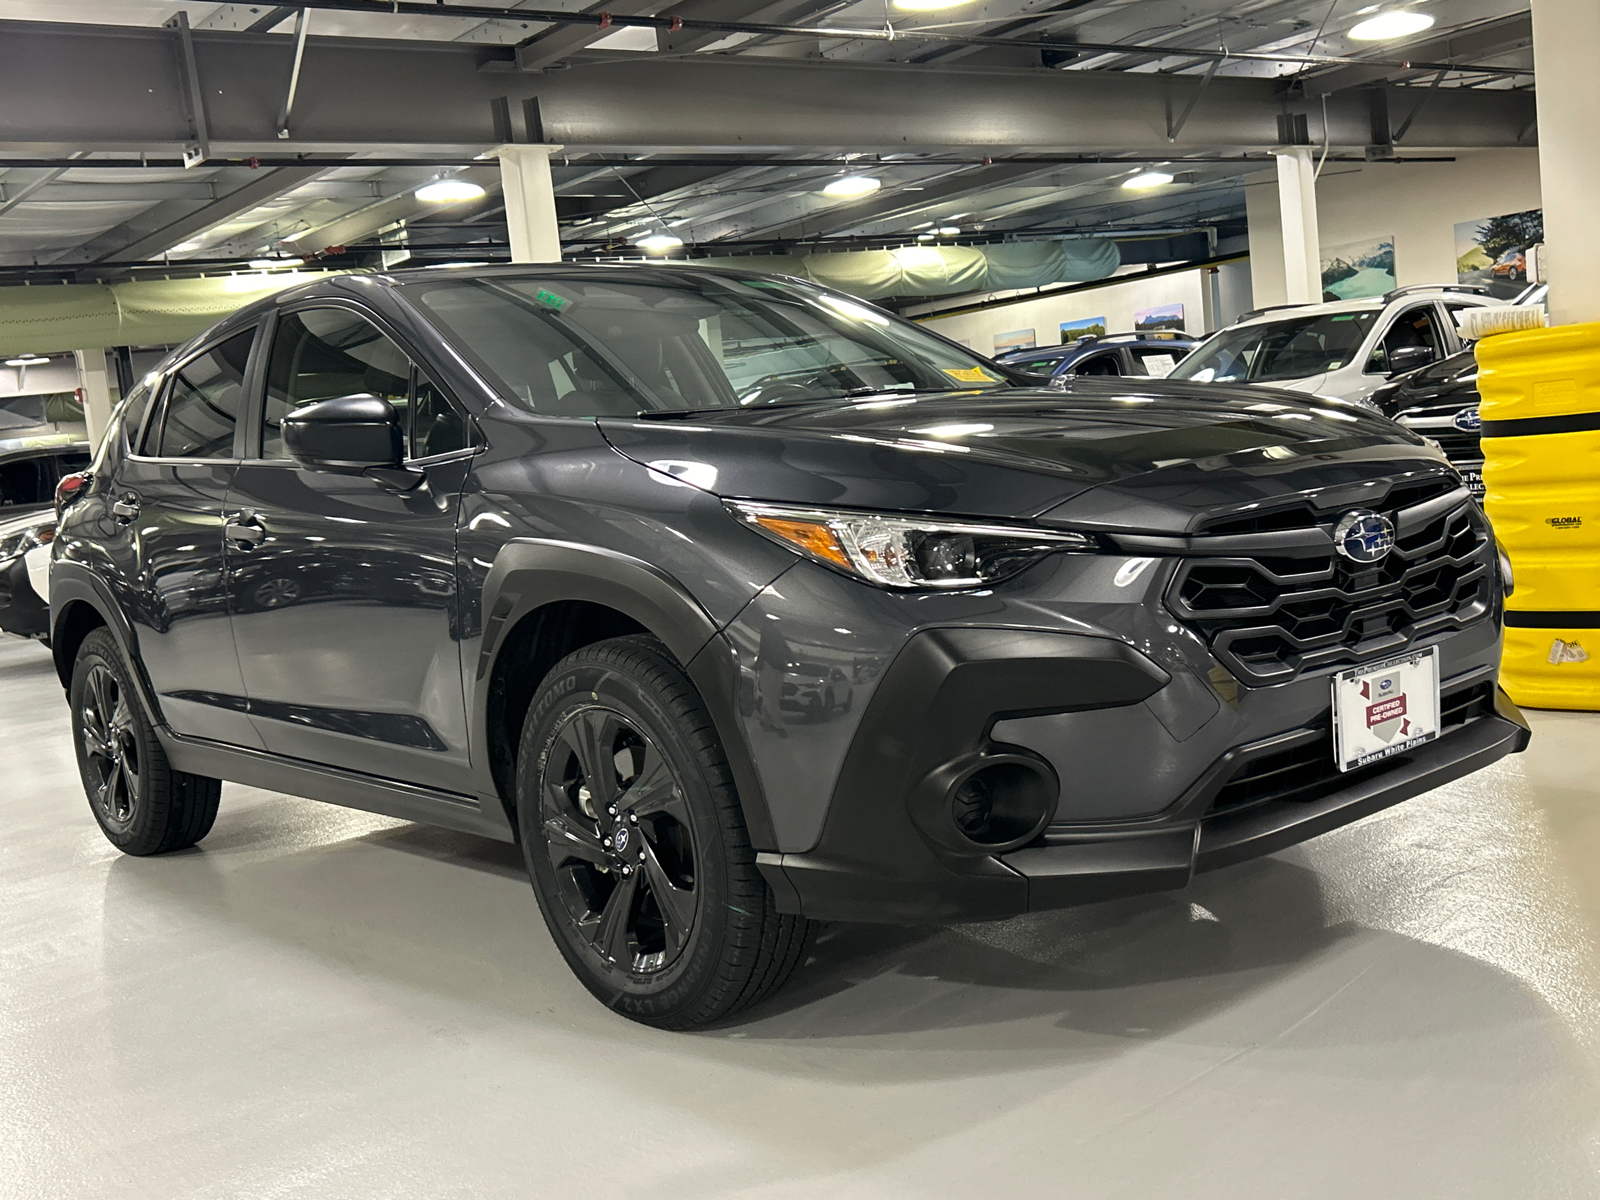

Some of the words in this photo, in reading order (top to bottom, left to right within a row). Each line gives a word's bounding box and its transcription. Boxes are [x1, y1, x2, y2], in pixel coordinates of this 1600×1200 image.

[1551, 516, 1582, 524] GLOBAL
[1370, 706, 1403, 723] PRE-OWNED
[1372, 700, 1400, 715] CERTIFIED
[1357, 751, 1383, 766] Subaru
[1384, 744, 1405, 756] White
[1406, 736, 1426, 749] Plains
